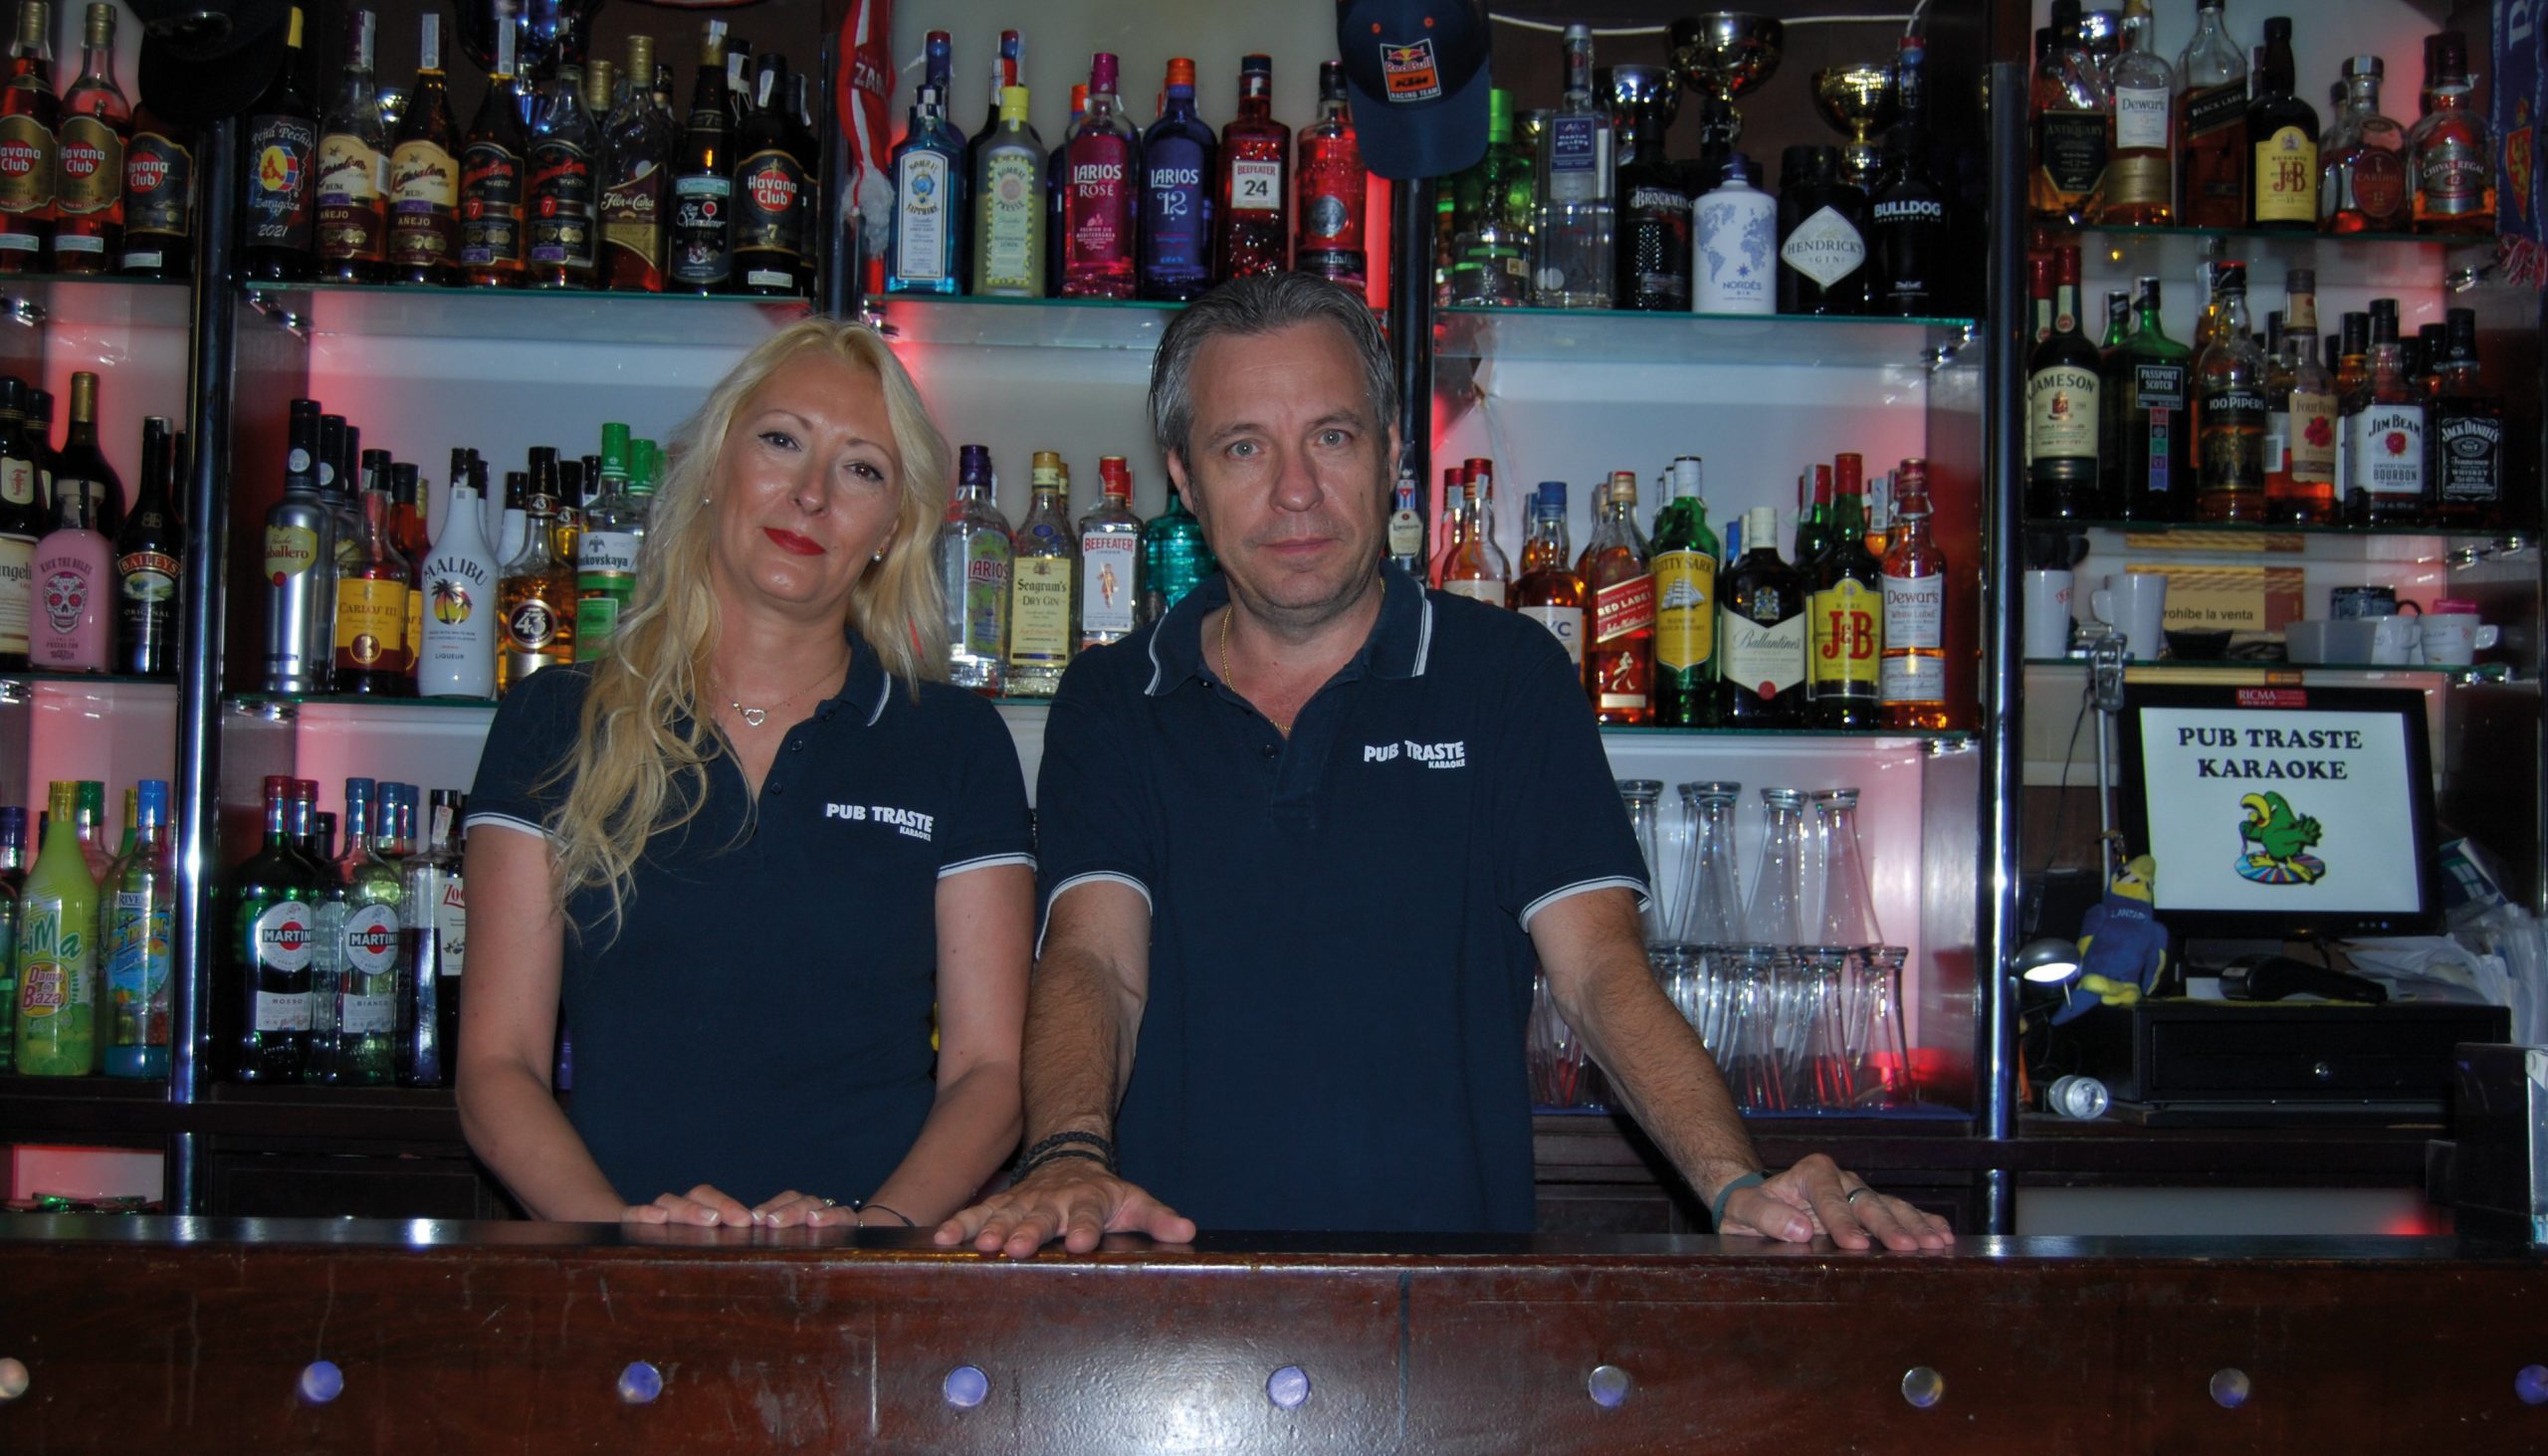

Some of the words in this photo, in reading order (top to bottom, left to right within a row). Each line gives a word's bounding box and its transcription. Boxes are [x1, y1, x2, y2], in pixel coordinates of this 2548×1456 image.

[1419, 87, 1439, 97] TEAM
[2191, 103, 2221, 117] BLACK
[2045, 123, 2103, 137] ANTIQUARY
[0, 146, 42, 160] avana
[60, 145, 106, 161] Havana
[1, 157, 31, 172] Club
[66, 159, 95, 173] Club
[1237, 164, 1276, 176] BEEFEATER
[2456, 160, 2485, 174] REGAL
[129, 172, 157, 187] Club
[1073, 163, 1123, 183] LARIOS
[1150, 168, 1199, 189] LARIOS
[2272, 160, 2307, 193] J&B
[747, 175, 797, 194] Havana
[1079, 183, 1115, 198] ROSÉ
[1244, 178, 1269, 197] 24
[600, 191, 625, 212] Flor
[757, 189, 788, 205] Club
[254, 197, 302, 218] Zaragoza
[472, 203, 479, 216] 7
[544, 199, 553, 212] 7
[1872, 200, 1942, 219] BULLDOG
[319, 209, 349, 220] AÑEJO
[398, 215, 431, 228] AÑEJO
[257, 223, 290, 239] 2021
[766, 223, 779, 240] 7
[2141, 368, 2179, 381] PASSPORT
[2030, 373, 2096, 398] JAMESON
[2145, 380, 2174, 391] SCOTCH
[2209, 398, 2229, 410] 100
[2229, 396, 2264, 410] PIPERS
[2295, 401, 2319, 413] Four
[2368, 415, 2390, 438] JIM
[2391, 413, 2422, 439] BEAM
[2441, 424, 2463, 442] JACK
[2463, 420, 2500, 444] DANIEL'S
[2373, 469, 2418, 482] BOURBON
[532, 498, 547, 511] 43
[557, 510, 571, 523] 43
[264, 545, 310, 559] aballero
[1084, 536, 1135, 553] BEEFEATER
[58, 556, 73, 567] THE
[120, 554, 178, 574] BAILEYS
[1686, 556, 1713, 573] SARK
[424, 555, 489, 587] MALIBU
[967, 559, 1009, 581] LARIOS
[1016, 577, 1068, 594] Seagram's
[1022, 595, 1042, 606] DRY
[1042, 595, 1060, 606] GIN
[1596, 602, 1619, 617] RED
[1619, 591, 1652, 608] LABEL
[1886, 589, 1940, 605] Dewar's
[338, 602, 381, 614] CARLOS
[384, 604, 397, 617] III
[2164, 607, 2203, 621] rohíbe
[2206, 607, 2217, 620] la
[2221, 610, 2253, 621] venta
[515, 610, 546, 635] 43
[1733, 627, 1802, 650] Ballantine's
[1821, 610, 1873, 660] J&B
[2238, 689, 2277, 701] RICMA
[2177, 727, 2238, 747] PUB
[2244, 728, 2363, 750] TRASTE
[1363, 742, 1399, 762] PUB
[1403, 739, 1465, 761] TRASTE
[1427, 758, 1466, 769] KARAOKE
[2197, 758, 2349, 780] KARAOKE
[825, 802, 867, 821] PUB
[871, 805, 935, 834] TRASTE
[899, 825, 932, 843] KARAOKE
[263, 929, 312, 943] MARTIN
[29, 965, 65, 983] Dama
[22, 983, 63, 1009] Baza
